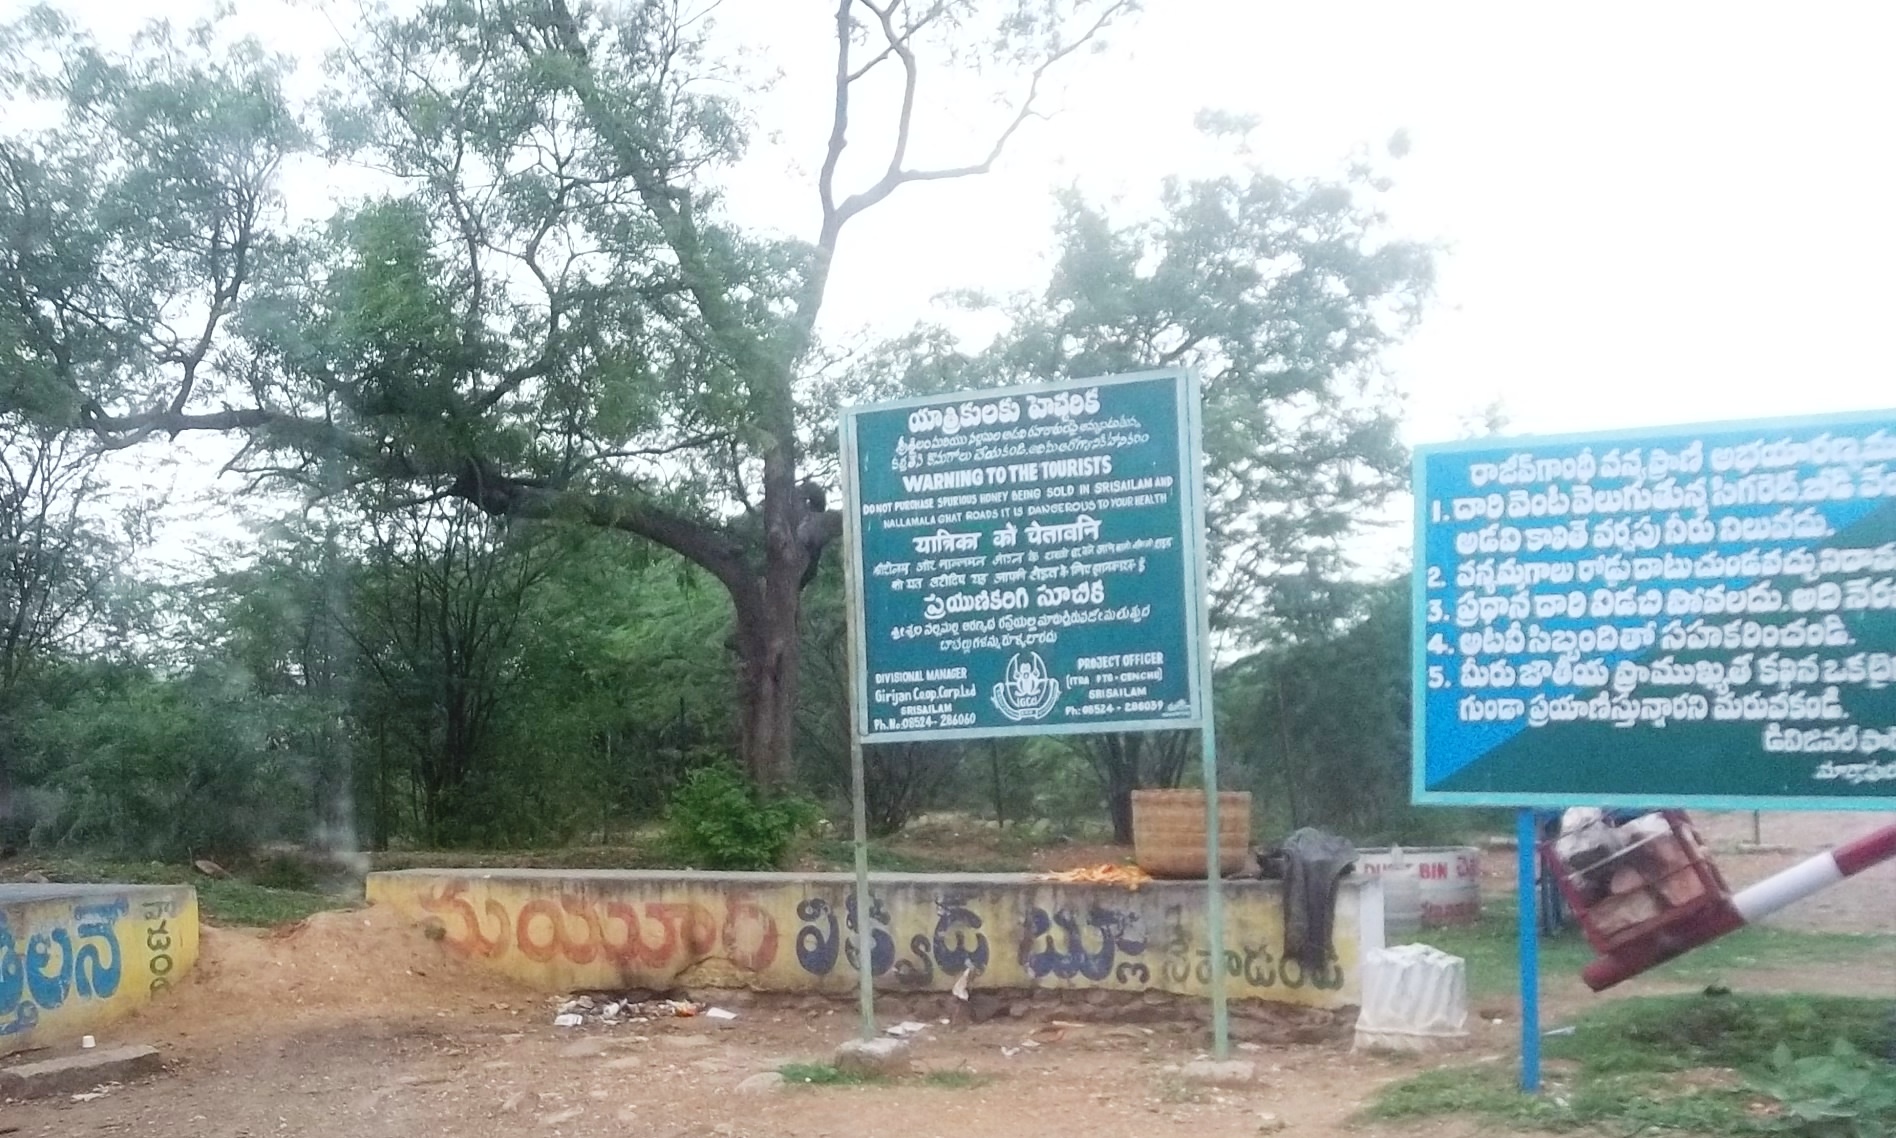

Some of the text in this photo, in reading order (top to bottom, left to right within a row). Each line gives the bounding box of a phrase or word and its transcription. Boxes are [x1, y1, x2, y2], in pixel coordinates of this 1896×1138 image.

[903, 455, 1112, 492] WARNING TO THE TOURISTS
[863, 475, 1173, 515] DO NOT PURCHASE SPURIOUS HONEY BEING SOLD IN SRISAILAM AND
[883, 493, 1167, 529] NALLAMALA GHAT ROADS IT IS DANGEROUS TO YOUR HEALTH
[1077, 651, 1164, 670] PROJECT OFFICER
[875, 667, 967, 684] DIVISIONAL MANAGER
[875, 687, 912, 706] Girijan
[1088, 686, 1147, 700] SRISAILAM
[900, 702, 953, 716] SRISAILAM
[1419, 862, 1448, 880] BIN
